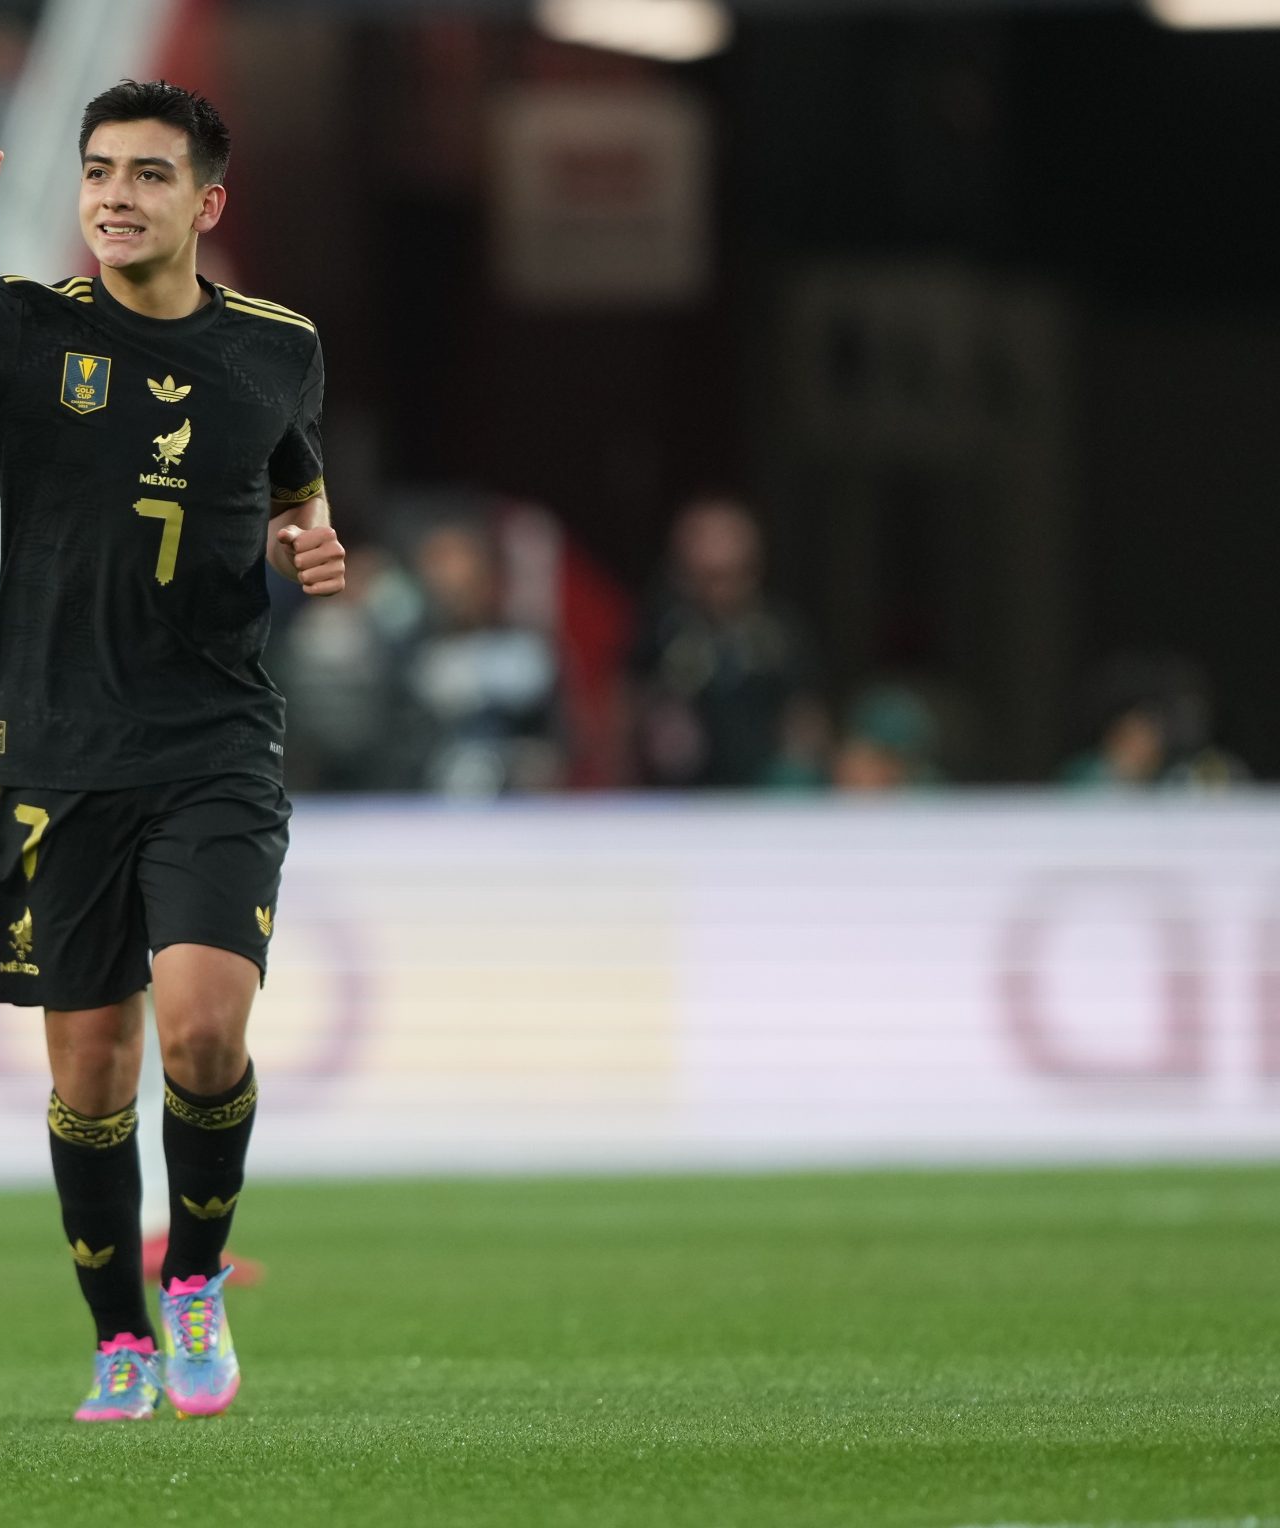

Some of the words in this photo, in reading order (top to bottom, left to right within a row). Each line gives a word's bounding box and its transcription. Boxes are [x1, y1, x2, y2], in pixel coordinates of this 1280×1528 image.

[74, 387, 96, 395] GOLD
[76, 392, 92, 400] CUP
[139, 473, 188, 489] MÉXICO
[132, 497, 185, 586] 7
[14, 803, 50, 882] 7
